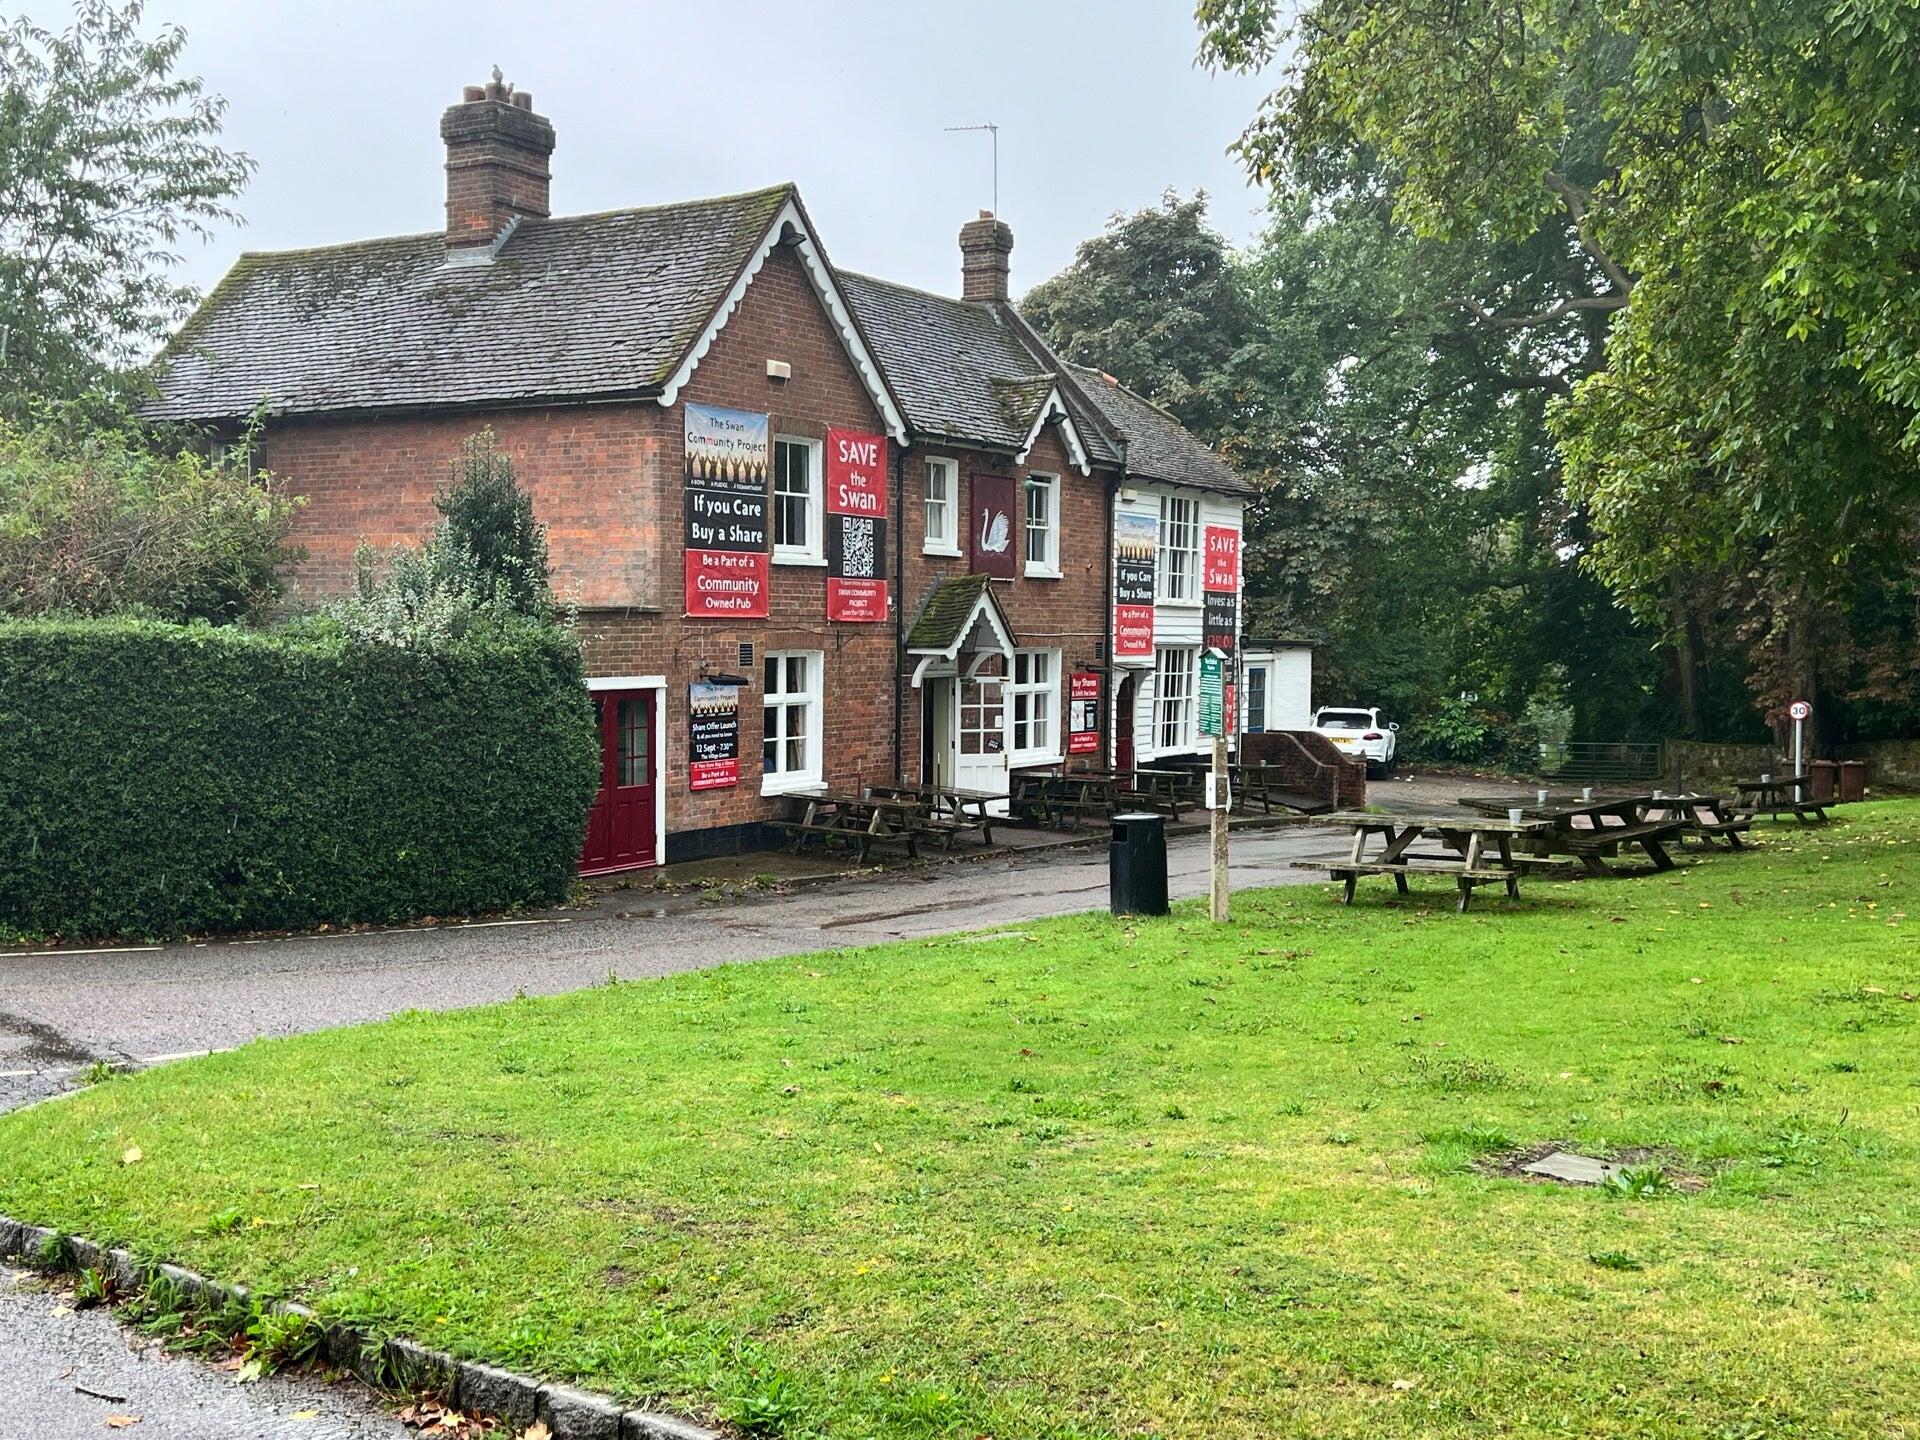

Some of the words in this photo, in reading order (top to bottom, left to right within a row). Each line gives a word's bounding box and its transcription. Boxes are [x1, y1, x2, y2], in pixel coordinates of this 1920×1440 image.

[710, 418, 723, 429] The
[726, 420, 744, 431] Swan
[687, 432, 734, 450] Community
[737, 440, 766, 453] Project
[839, 440, 877, 466] SAVE
[850, 471, 866, 487] the
[839, 484, 876, 510] Swan
[694, 494, 703, 511] If
[707, 499, 730, 517] you
[733, 500, 761, 516] Care
[692, 523, 713, 544] Buy
[718, 529, 725, 541] a
[730, 525, 762, 543] Share
[1210, 535, 1234, 553] SAVE
[702, 555, 712, 565] Be
[721, 555, 736, 566] Part
[739, 556, 747, 567] of
[749, 559, 754, 567] a
[1217, 559, 1226, 567] the
[1121, 569, 1126, 580] If
[1127, 572, 1137, 583] you
[1139, 571, 1151, 582] Care
[1210, 568, 1233, 586] Swan
[697, 575, 759, 595] Community
[1120, 587, 1130, 600] Buy
[1136, 588, 1152, 599] Share
[1208, 594, 1225, 607] Invest
[1226, 598, 1235, 607] as
[706, 598, 734, 609] Owned
[736, 598, 751, 609] Pub
[1208, 613, 1224, 626] little
[1224, 617, 1233, 626] as
[1120, 625, 1151, 639] Community
[706, 722, 719, 730] Offer
[720, 721, 736, 729] Launch
[696, 744, 702, 752] 12
[703, 743, 716, 753] Sept
